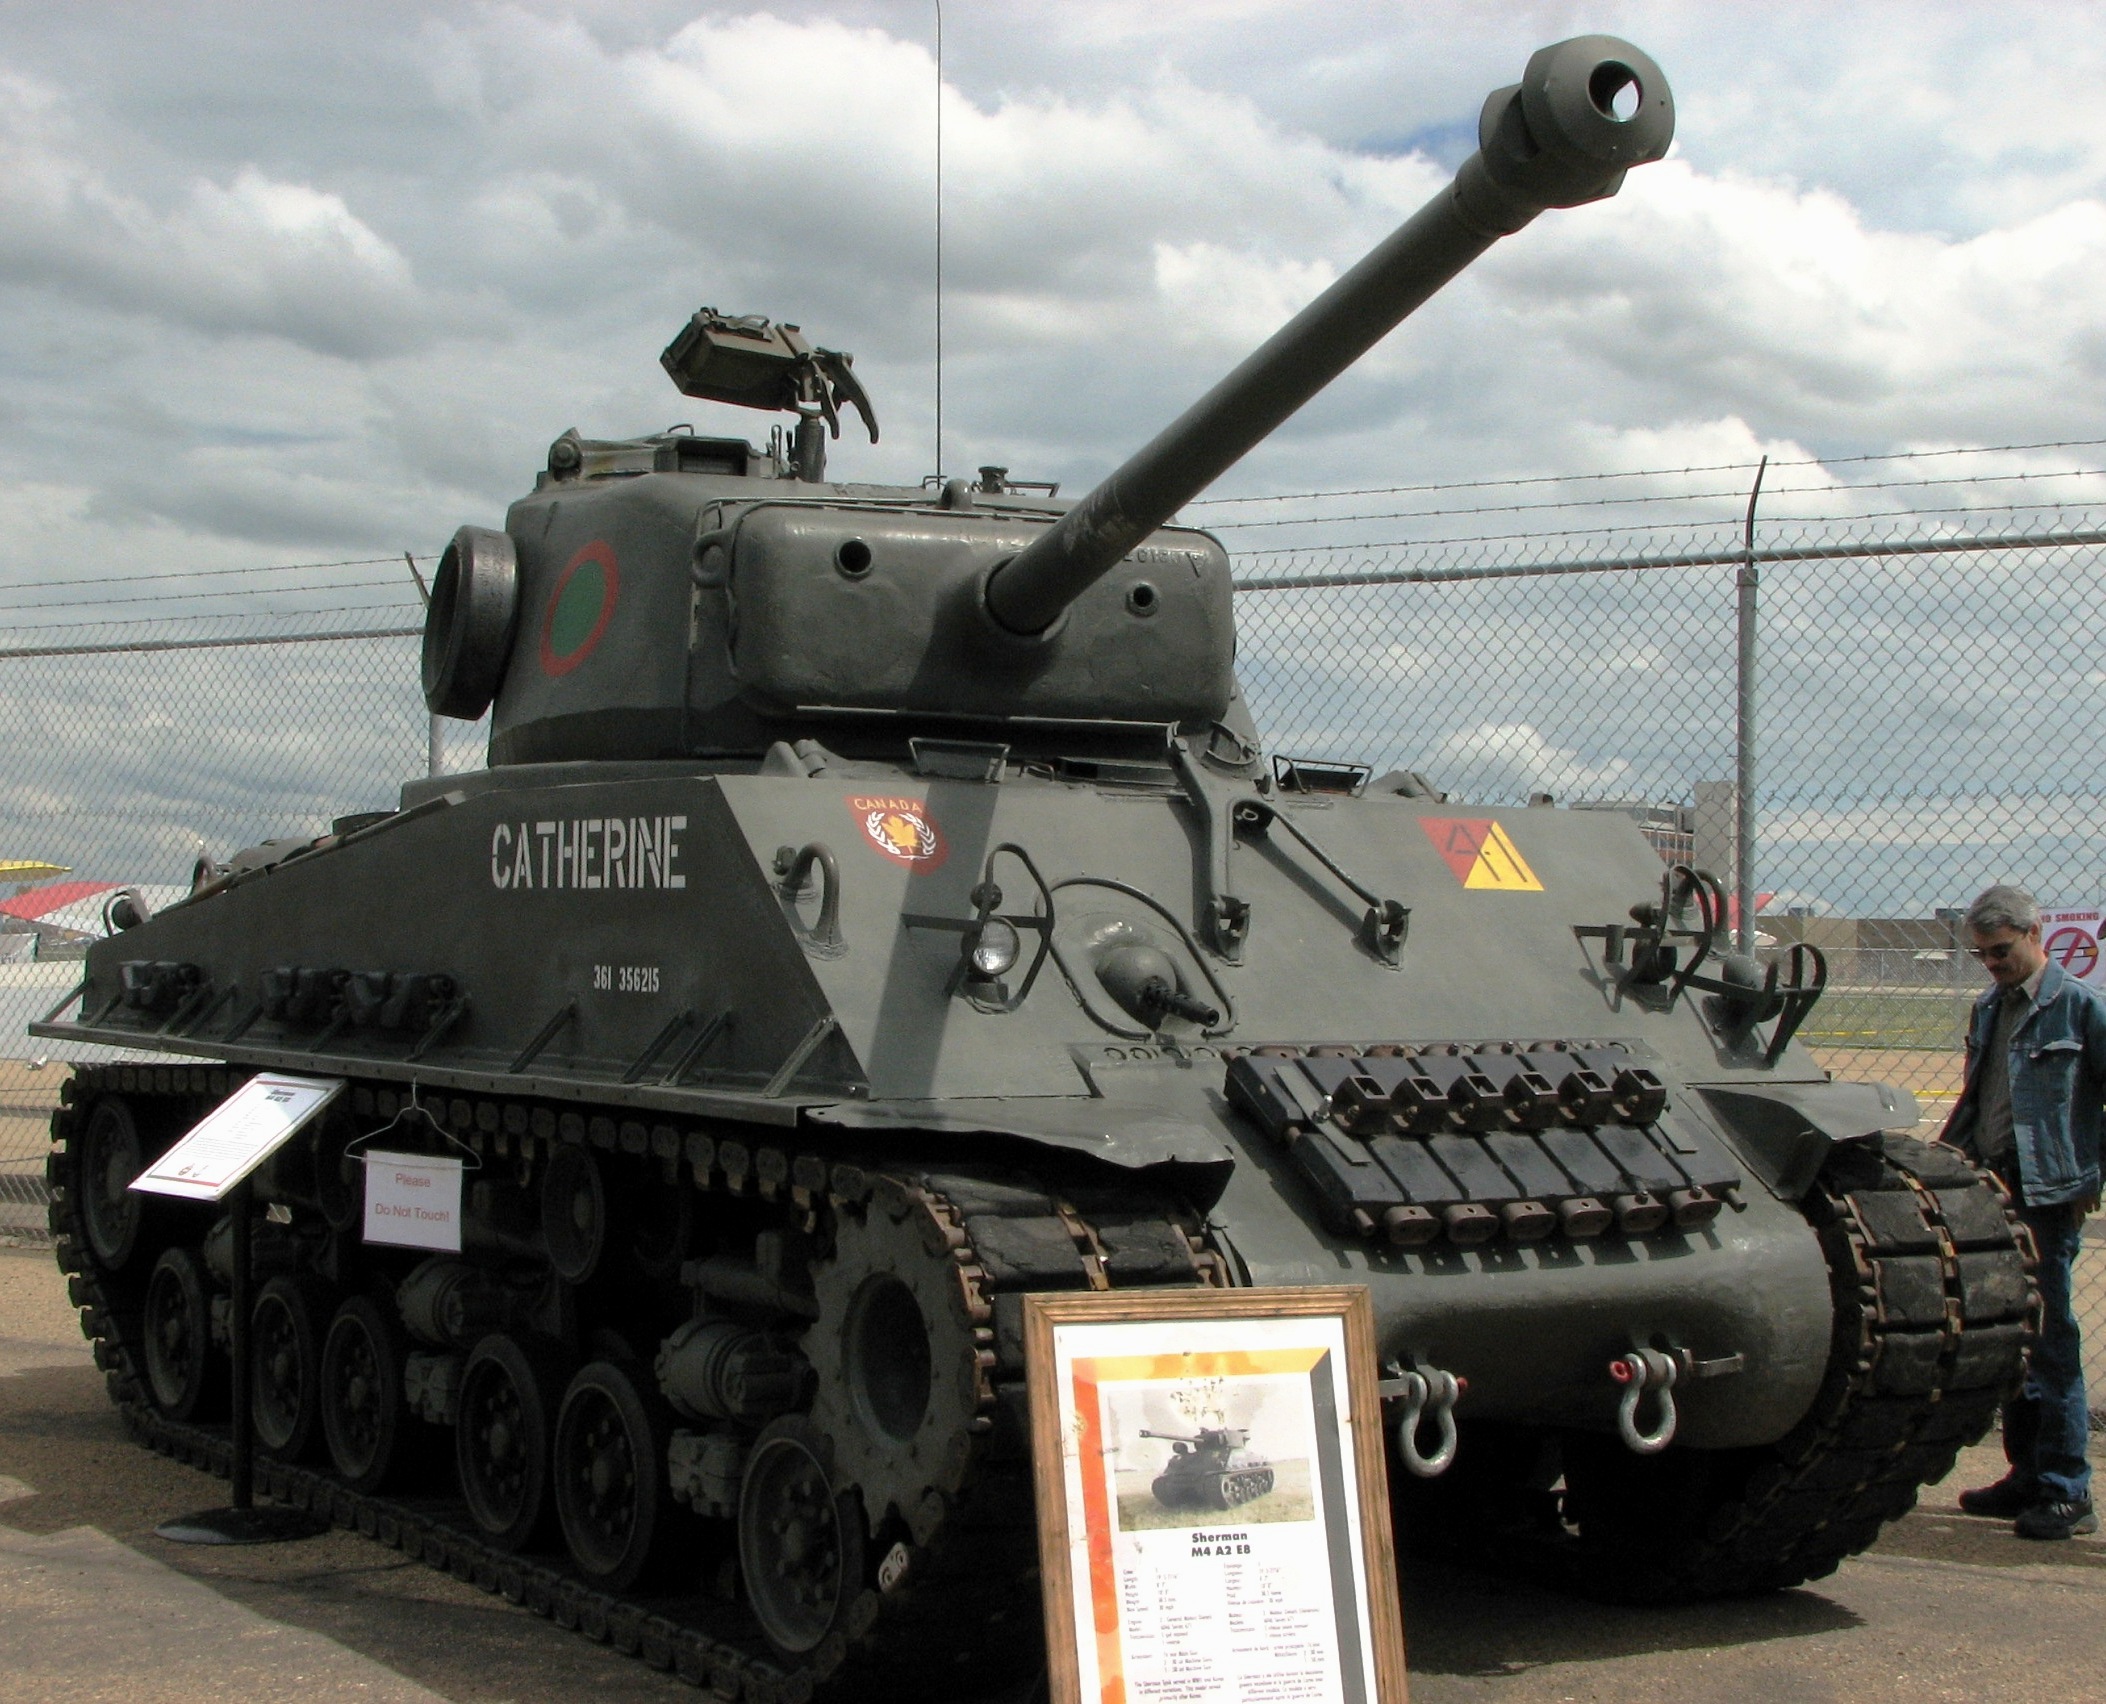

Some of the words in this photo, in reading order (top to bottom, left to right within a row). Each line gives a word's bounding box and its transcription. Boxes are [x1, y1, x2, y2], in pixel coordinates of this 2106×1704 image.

[854, 798, 923, 814] CANADA
[492, 815, 688, 889] CATHERINE
[2055, 912, 2099, 922] SMOKING
[619, 966, 660, 993] 356215
[395, 1172, 431, 1188] Please
[375, 1203, 390, 1216] Do
[393, 1205, 411, 1218] Not
[414, 1207, 450, 1222] Touch!
[1191, 1532, 1248, 1543] Sherman
[1191, 1546, 1211, 1557] M4
[1215, 1545, 1232, 1556] A2
